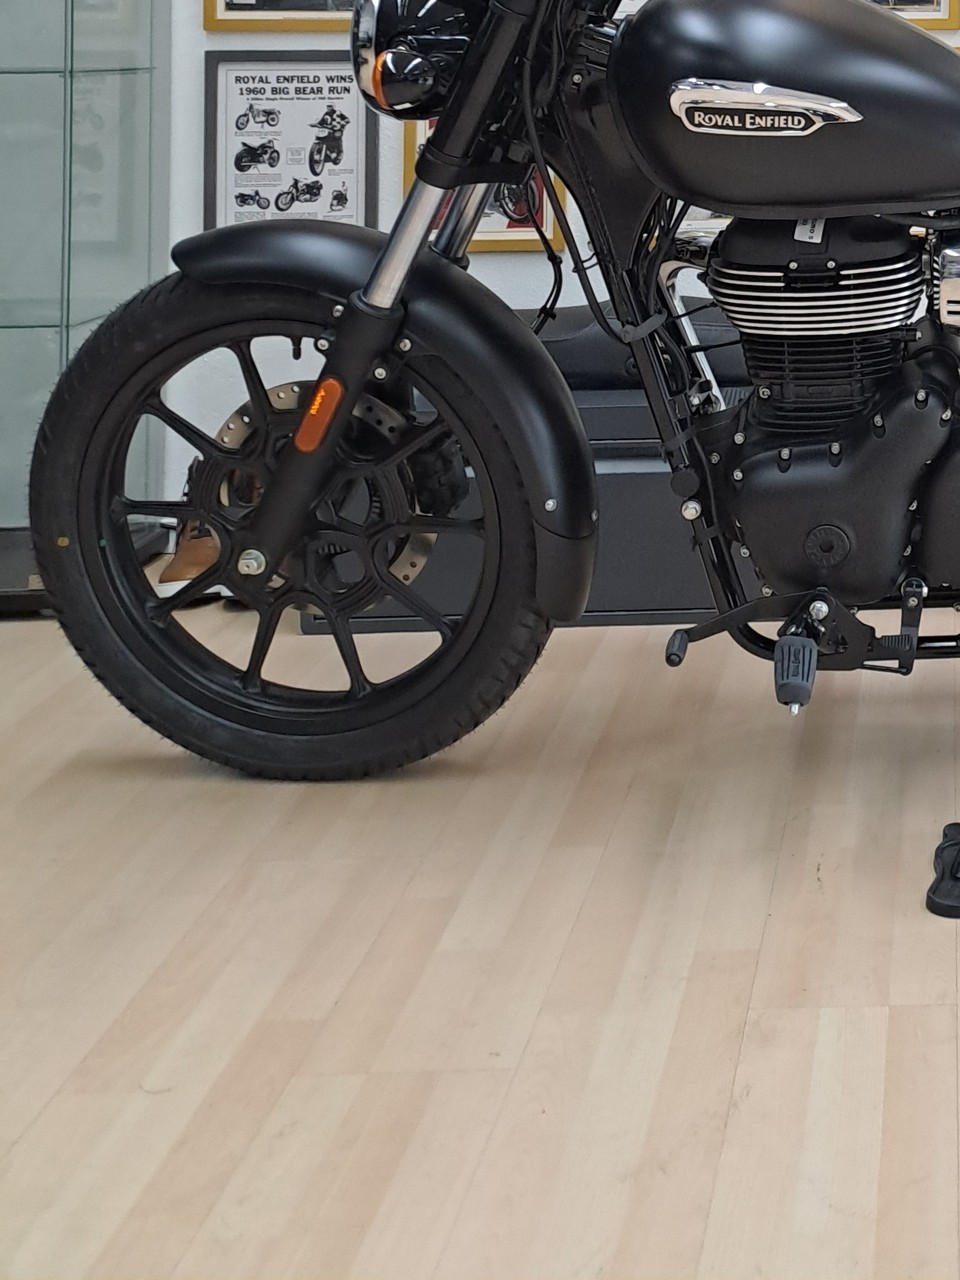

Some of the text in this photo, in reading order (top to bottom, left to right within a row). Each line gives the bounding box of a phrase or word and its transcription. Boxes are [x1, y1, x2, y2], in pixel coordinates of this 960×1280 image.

[234, 74, 354, 84] ROYAL ENFIELD WINS
[238, 86, 351, 96] 1960 BIG BEAR RUN
[694, 111, 806, 129] ROYAL ENFIELD
